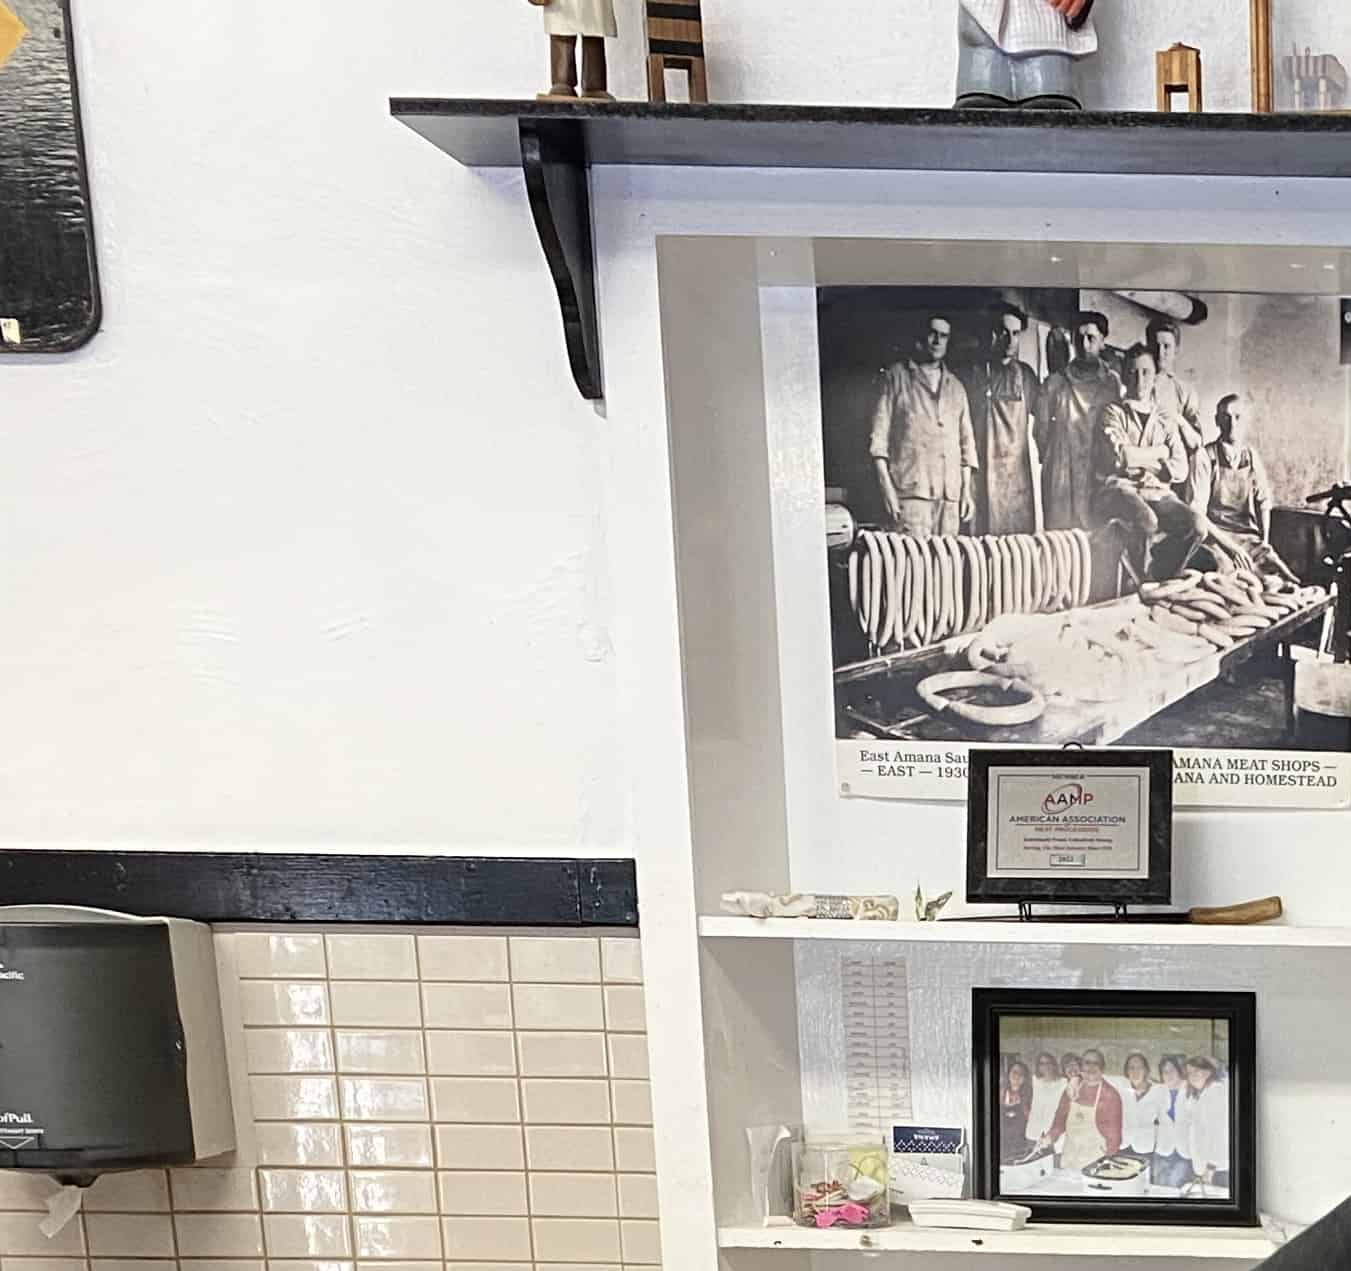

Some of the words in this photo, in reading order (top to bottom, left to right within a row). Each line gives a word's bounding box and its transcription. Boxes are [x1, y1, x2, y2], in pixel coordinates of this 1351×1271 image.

[859, 750, 889, 762] East
[894, 752, 941, 763] Amana
[878, 765, 915, 777] EAST
[1227, 758, 1267, 771] MEAT
[1271, 760, 1320, 772] SHOPS
[1209, 773, 1240, 785] AND
[1244, 774, 1337, 787] HOMESTEAD
[1044, 793, 1094, 806] AAMP
[1009, 815, 1060, 823] AMERICAN
[1062, 816, 1126, 824] ASSOCIATION
